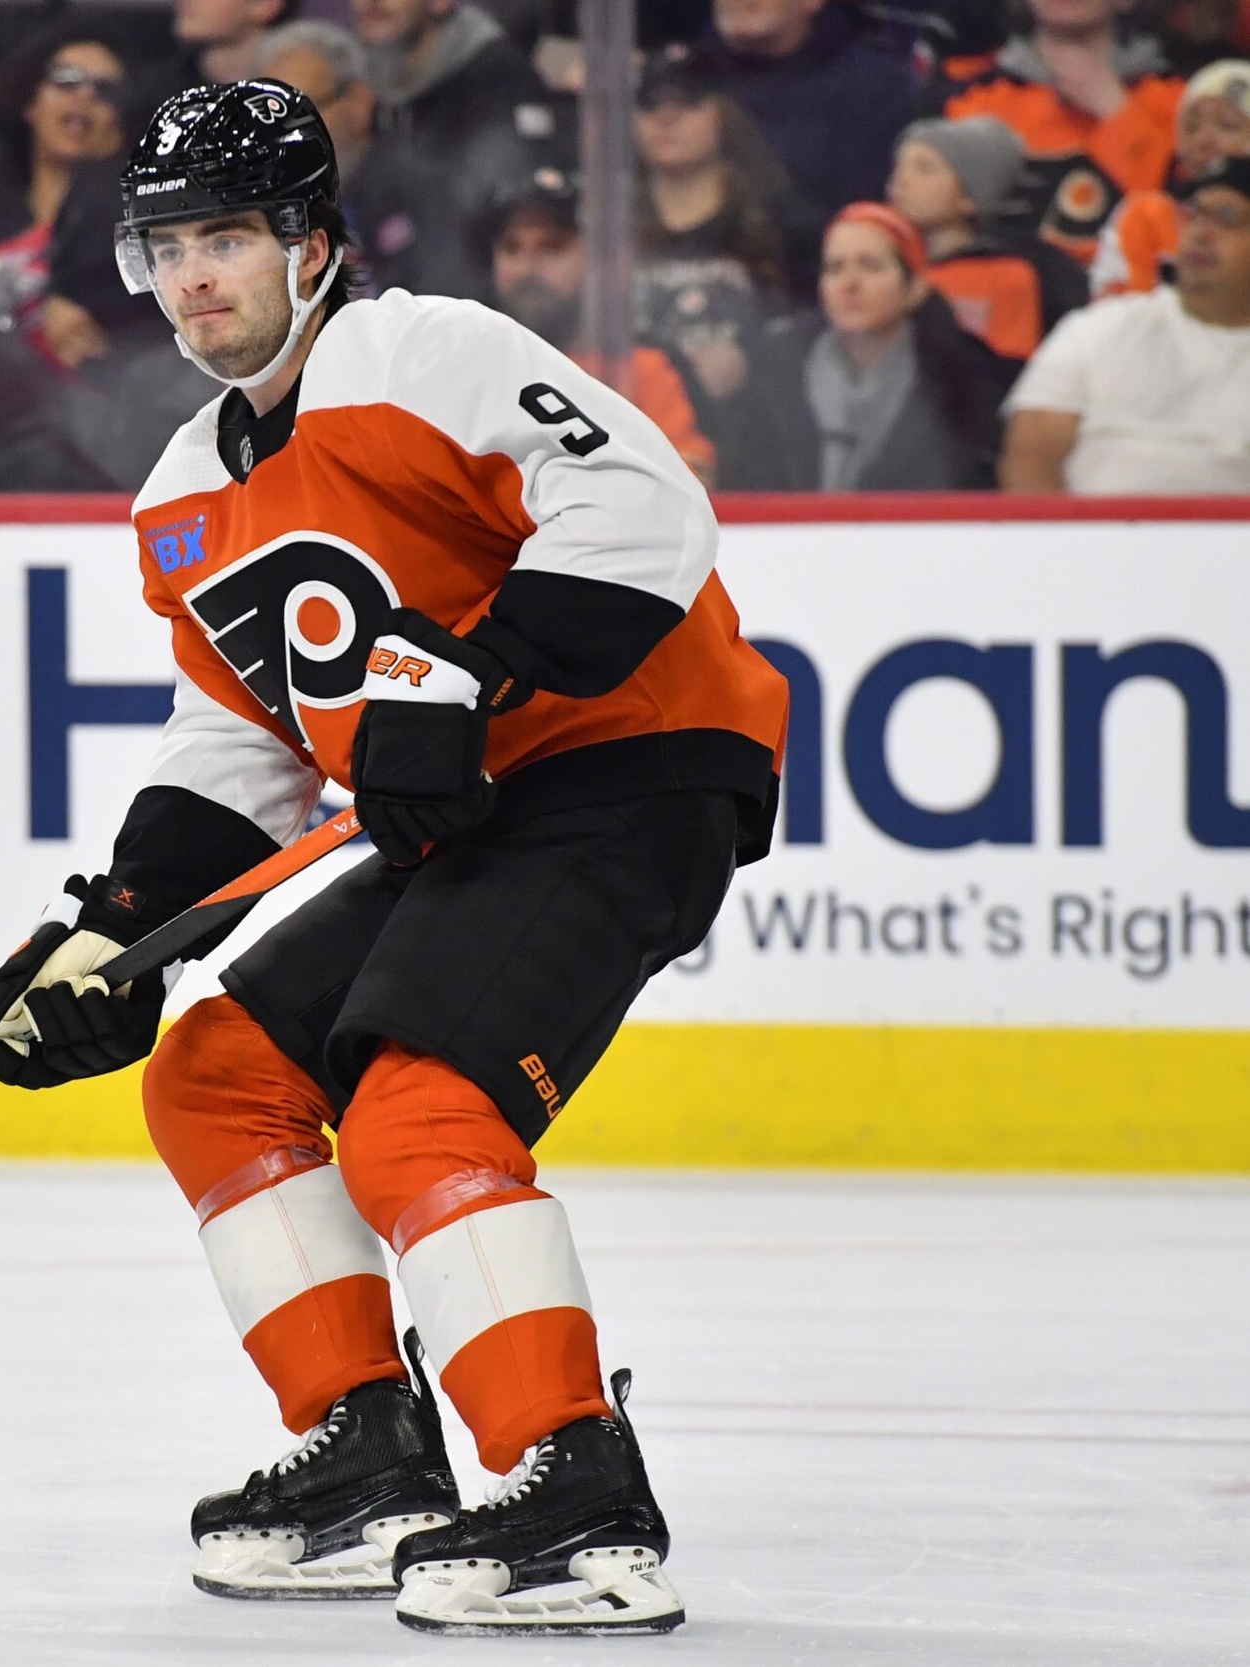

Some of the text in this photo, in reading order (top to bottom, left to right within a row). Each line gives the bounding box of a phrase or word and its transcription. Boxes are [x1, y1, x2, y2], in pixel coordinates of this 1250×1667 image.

[136, 177, 187, 196] BAUER
[518, 382, 610, 457] 9
[744, 884, 1024, 957] What's
[517, 1053, 563, 1120] BAU
